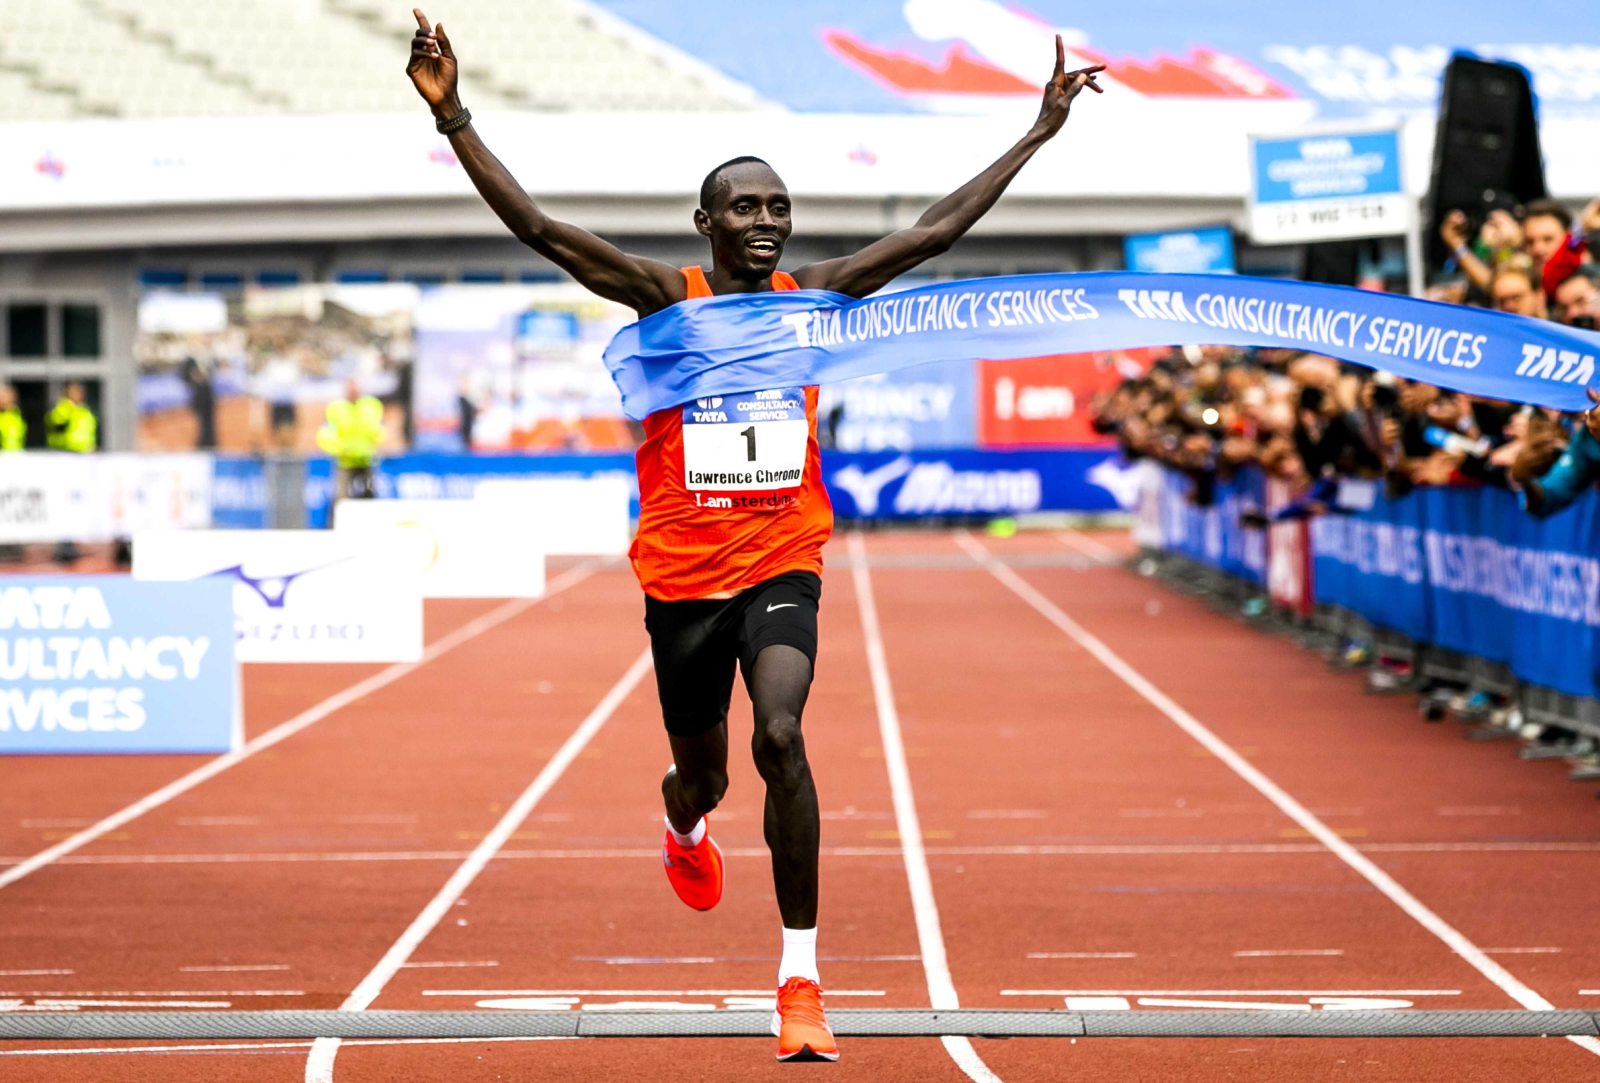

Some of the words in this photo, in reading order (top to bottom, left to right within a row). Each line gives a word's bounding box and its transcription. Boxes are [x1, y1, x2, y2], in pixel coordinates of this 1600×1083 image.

[782, 310, 843, 347] TATA
[847, 292, 985, 342] CONSULTANCY
[986, 287, 1098, 327] SERVICES
[1118, 289, 1198, 324] TATA
[1195, 293, 1366, 348] CONSULTANCY
[1364, 316, 1487, 369] SERVICES
[1515, 343, 1595, 385] TATA
[755, 389, 782, 400] TATA
[737, 400, 797, 411] CONSULTANCY
[692, 411, 728, 423] TATA
[749, 410, 789, 421] SERVICES
[740, 426, 756, 462] 1
[689, 470, 752, 484] Lawrence
[756, 468, 801, 483] Cherono
[0, 586, 112, 630] ATA
